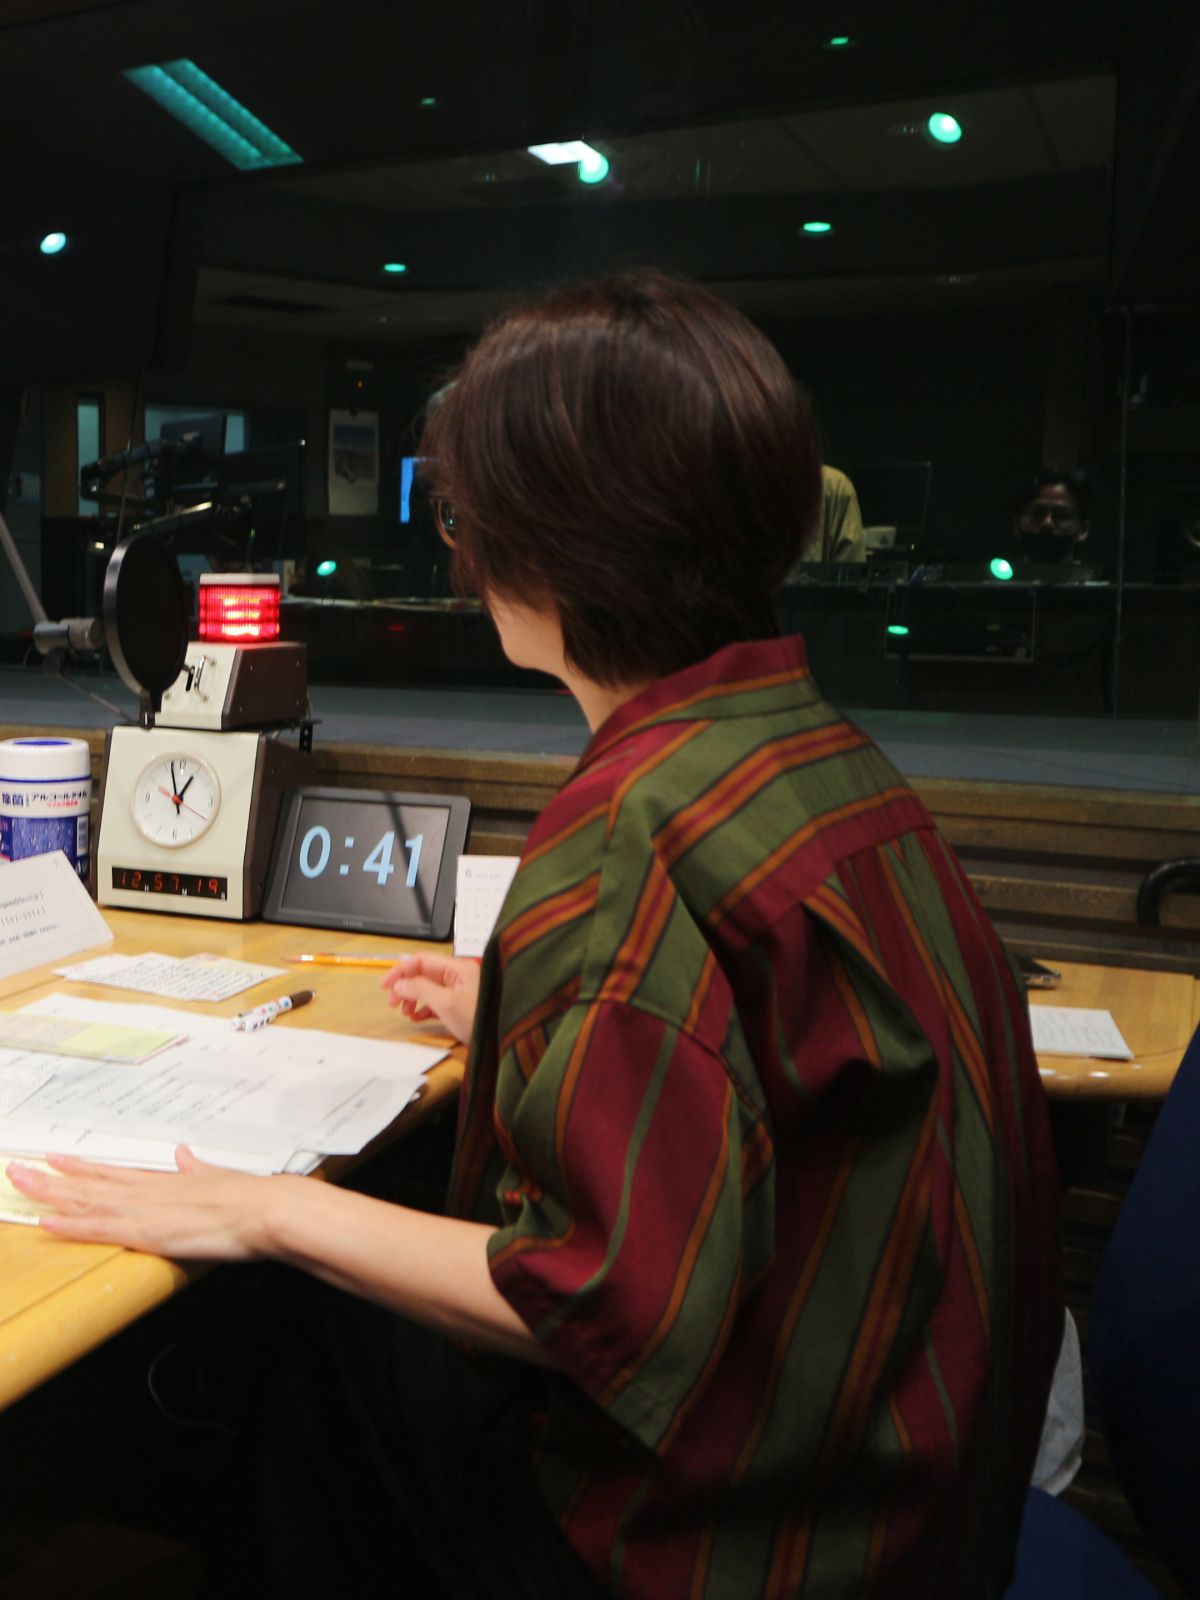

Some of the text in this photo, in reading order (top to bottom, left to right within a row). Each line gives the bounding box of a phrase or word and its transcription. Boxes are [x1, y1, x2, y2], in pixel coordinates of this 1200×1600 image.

[299, 825, 424, 888] 0:41
[120, 871, 142, 887] 12
[154, 873, 180, 892] 57
[197, 879, 219, 895] 19
